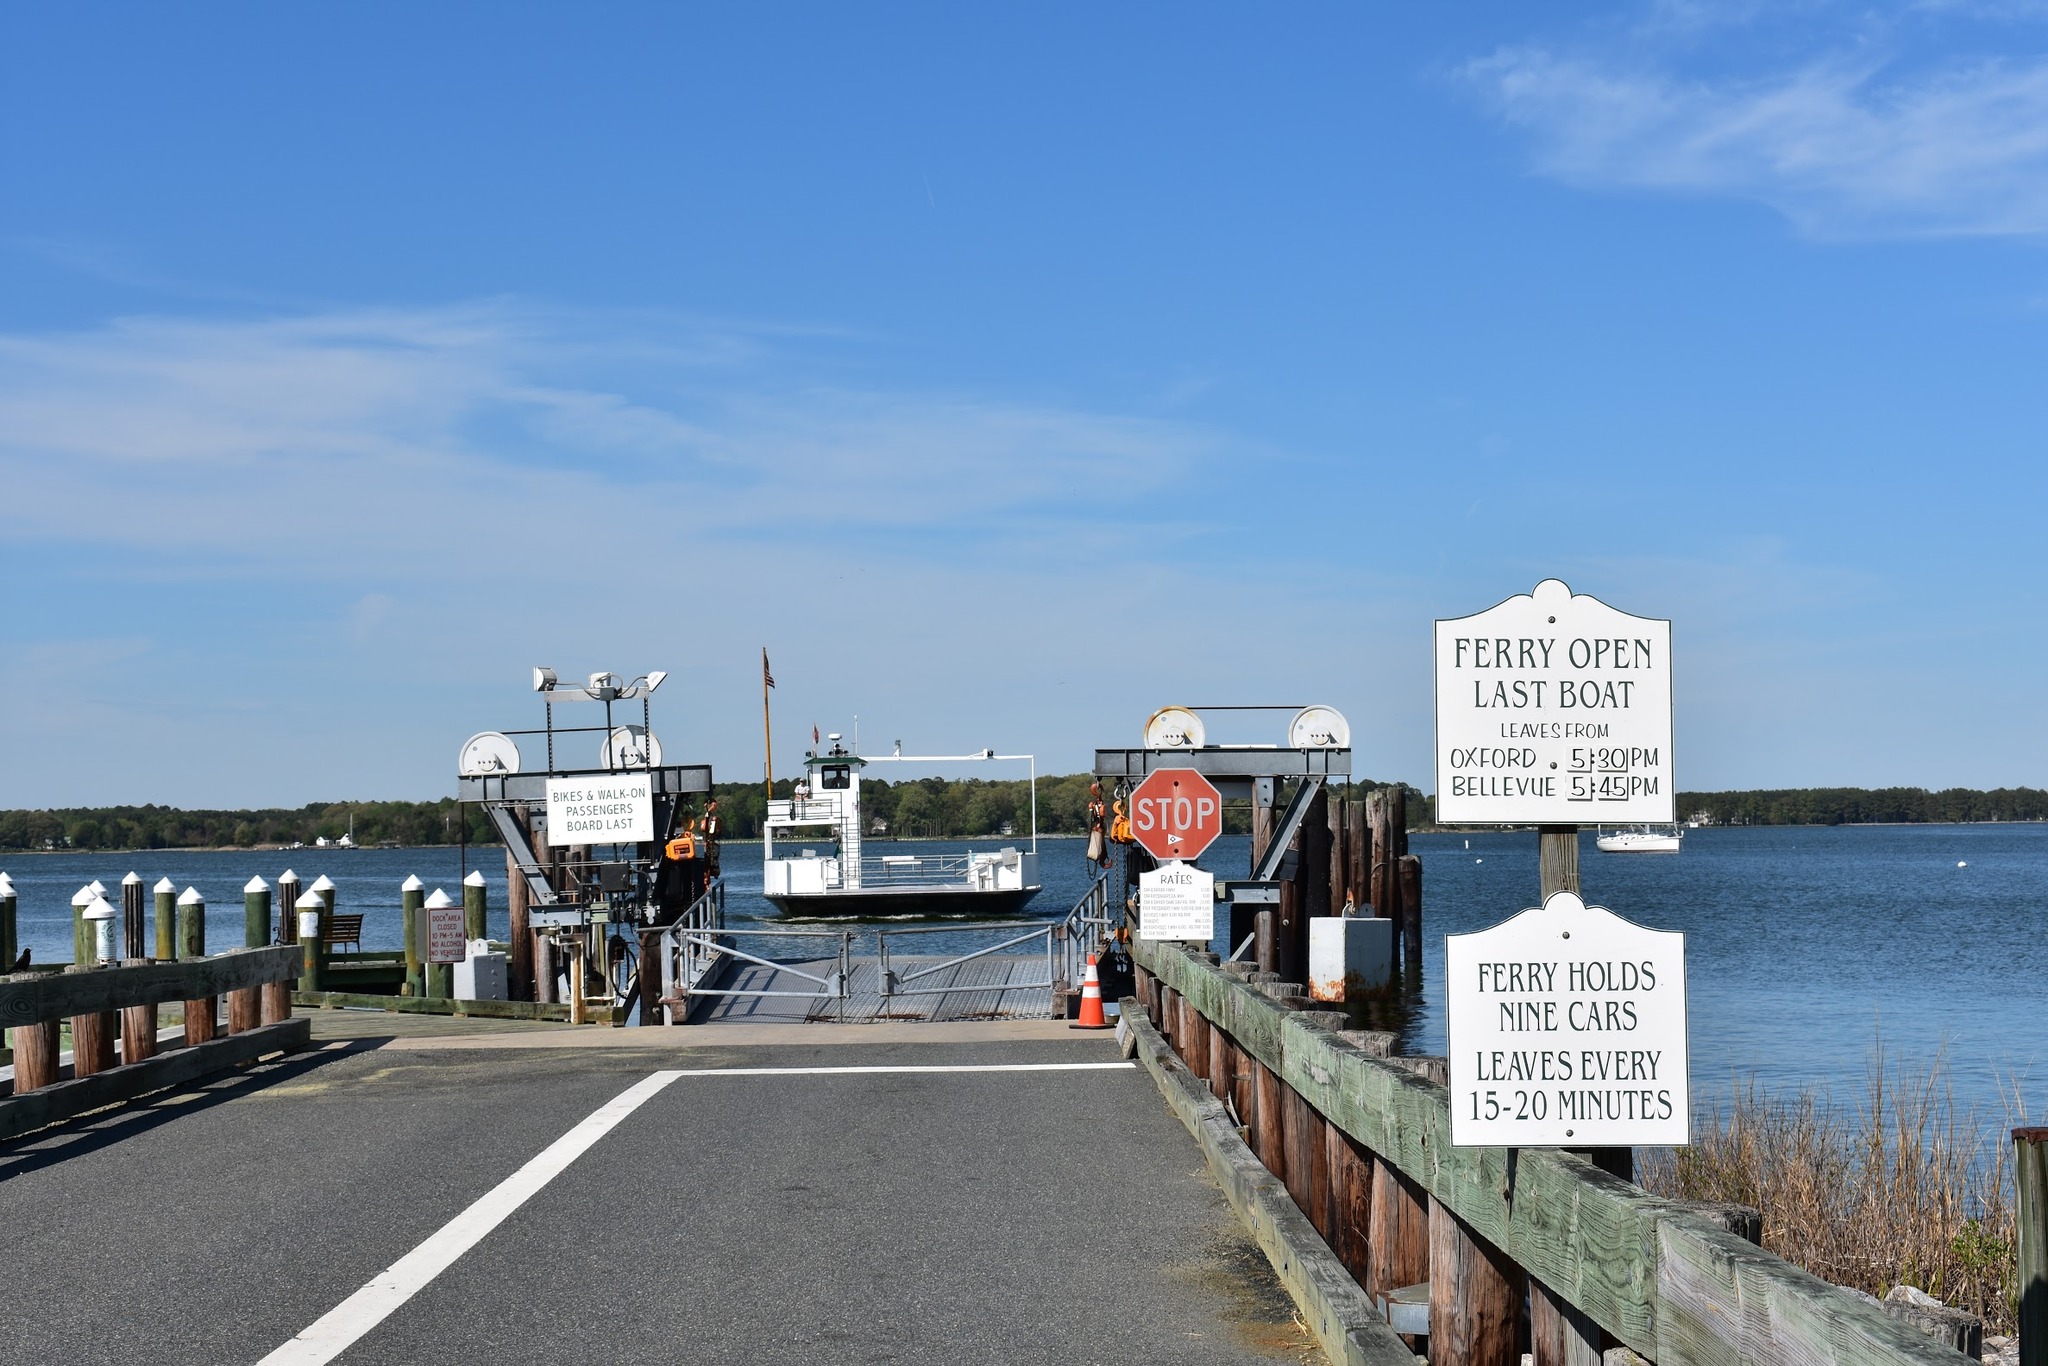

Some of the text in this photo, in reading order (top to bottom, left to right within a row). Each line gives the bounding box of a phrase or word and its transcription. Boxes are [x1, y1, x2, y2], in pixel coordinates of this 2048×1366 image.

[1455, 638, 1652, 668] FERRY OPEN
[1474, 680, 1635, 708] LAST BOAT
[1501, 722, 1609, 738] LEAVES FROM
[1450, 746, 1537, 768] OXFORD
[553, 787, 646, 802] BIKES & WALK-ON
[1452, 775, 1556, 797] BELLEVUE
[566, 803, 633, 816] PASSENGERS
[1137, 797, 1215, 830] STOP
[567, 818, 633, 831] BOARD LAST
[1160, 874, 1192, 884] RATES
[1478, 960, 1656, 992] FERRY HOLDS
[1499, 1000, 1638, 1031] NINE CARS
[1476, 1050, 1662, 1080] LEAVES EVERY
[1470, 1089, 1673, 1120] 15-20 MINUTES
